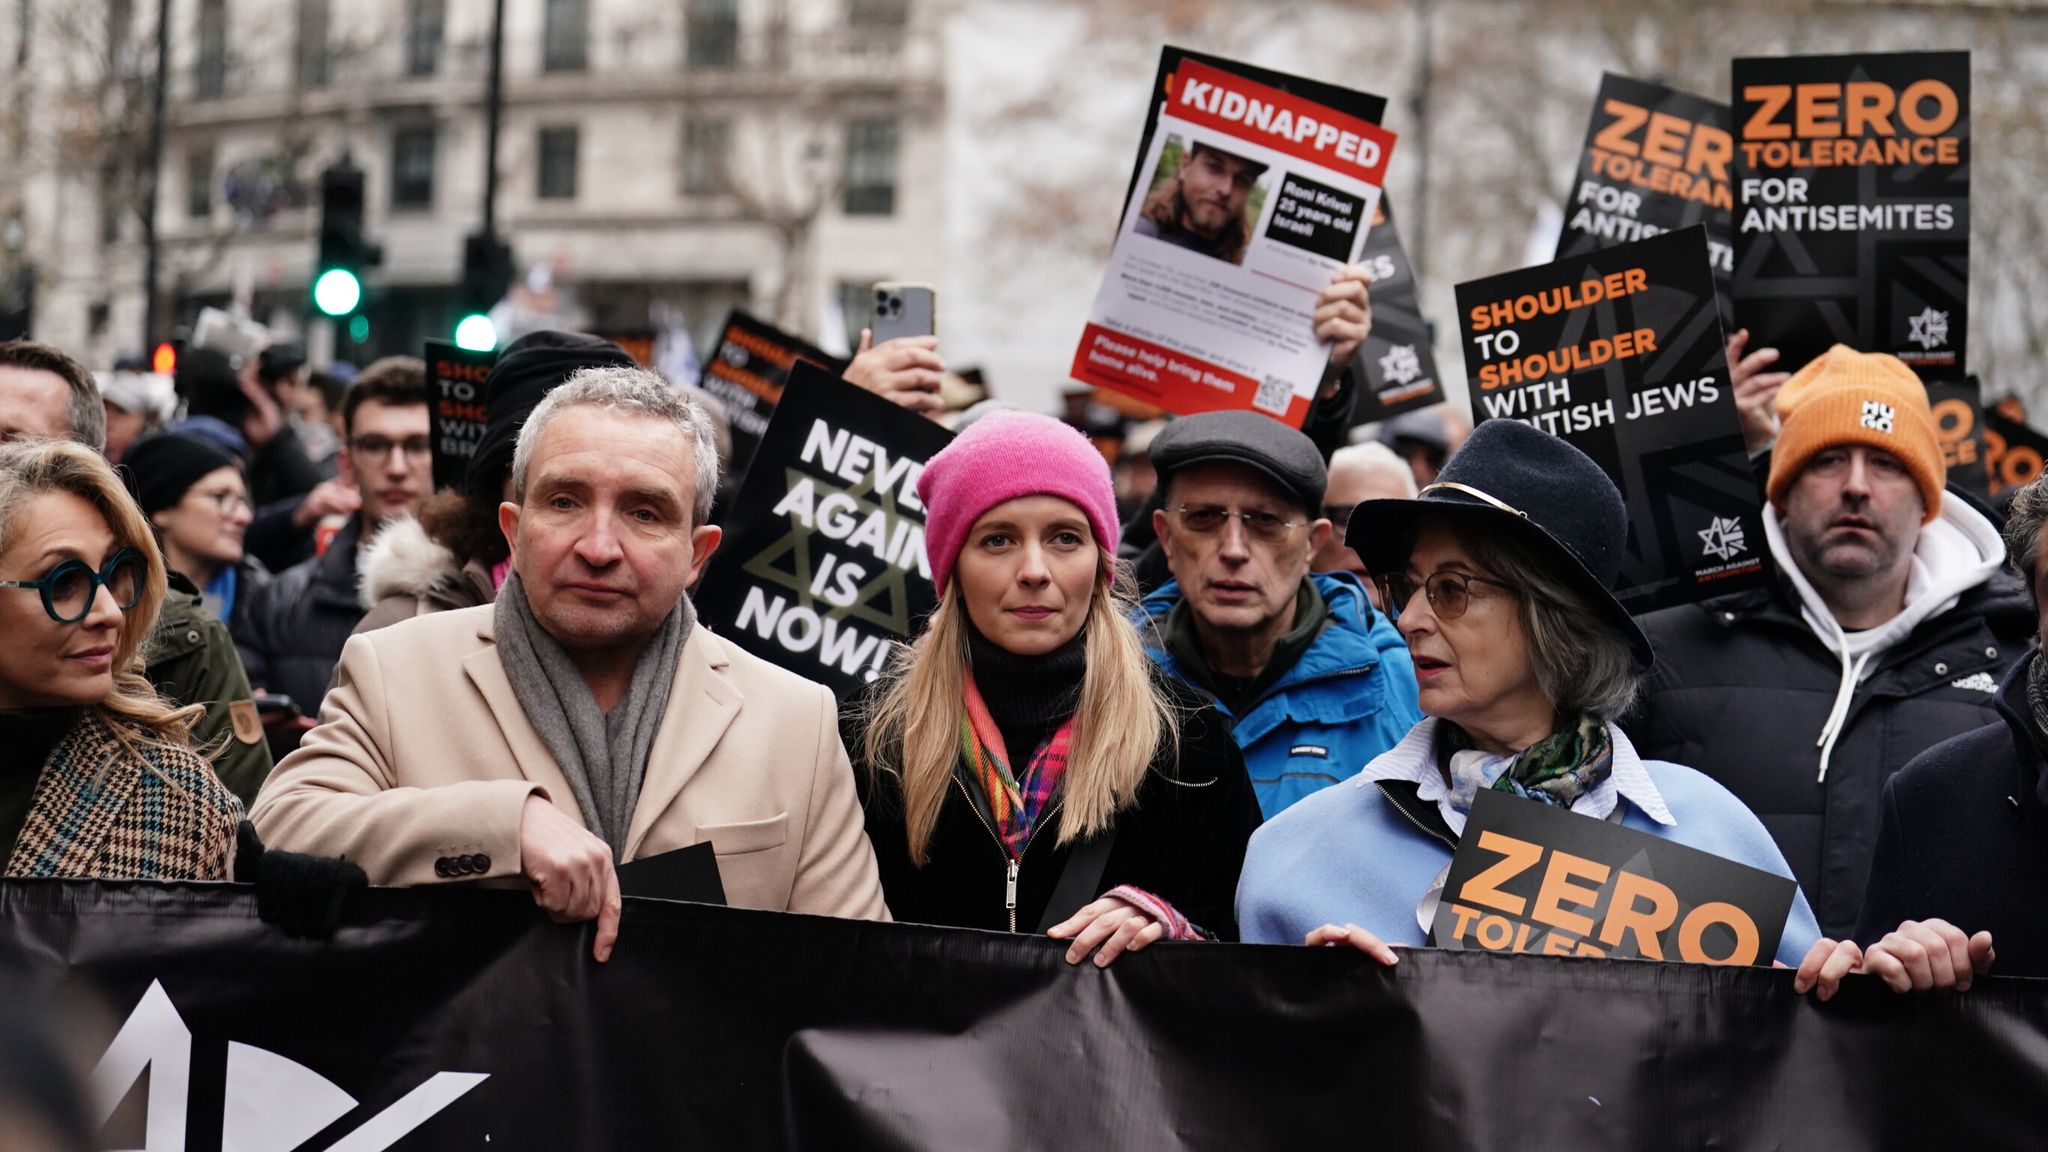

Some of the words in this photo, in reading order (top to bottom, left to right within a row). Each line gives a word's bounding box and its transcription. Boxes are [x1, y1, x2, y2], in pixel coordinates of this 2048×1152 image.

[1180, 78, 1381, 168] KIDNAPPED
[1742, 79, 1959, 139] ZERO
[1594, 99, 1733, 182] ZER
[1741, 137, 1959, 169] TOLERANCE
[1577, 180, 1642, 218] FOR
[1588, 148, 1733, 212] TOLERAN
[1741, 177, 1808, 204] FOR
[1296, 205, 1332, 226] years
[1740, 204, 1954, 233] ANTISEMITES
[1470, 267, 1648, 331] SHOULDER
[1088, 349, 1125, 370] home
[1094, 334, 1138, 359] Please
[1137, 349, 1167, 369] help
[1166, 358, 1201, 384] bring
[1200, 371, 1236, 394] them
[1474, 330, 1520, 360] TO
[1479, 327, 1658, 390] SHOULDER
[437, 379, 475, 401] TO
[1483, 378, 1571, 419] WITH
[1522, 399, 1615, 437] ITISH
[1625, 377, 1719, 420] JEWS
[800, 418, 928, 516] NEVE
[810, 553, 867, 608] IS
[735, 585, 891, 683] NOW!
[1459, 830, 1760, 967] ZERO
